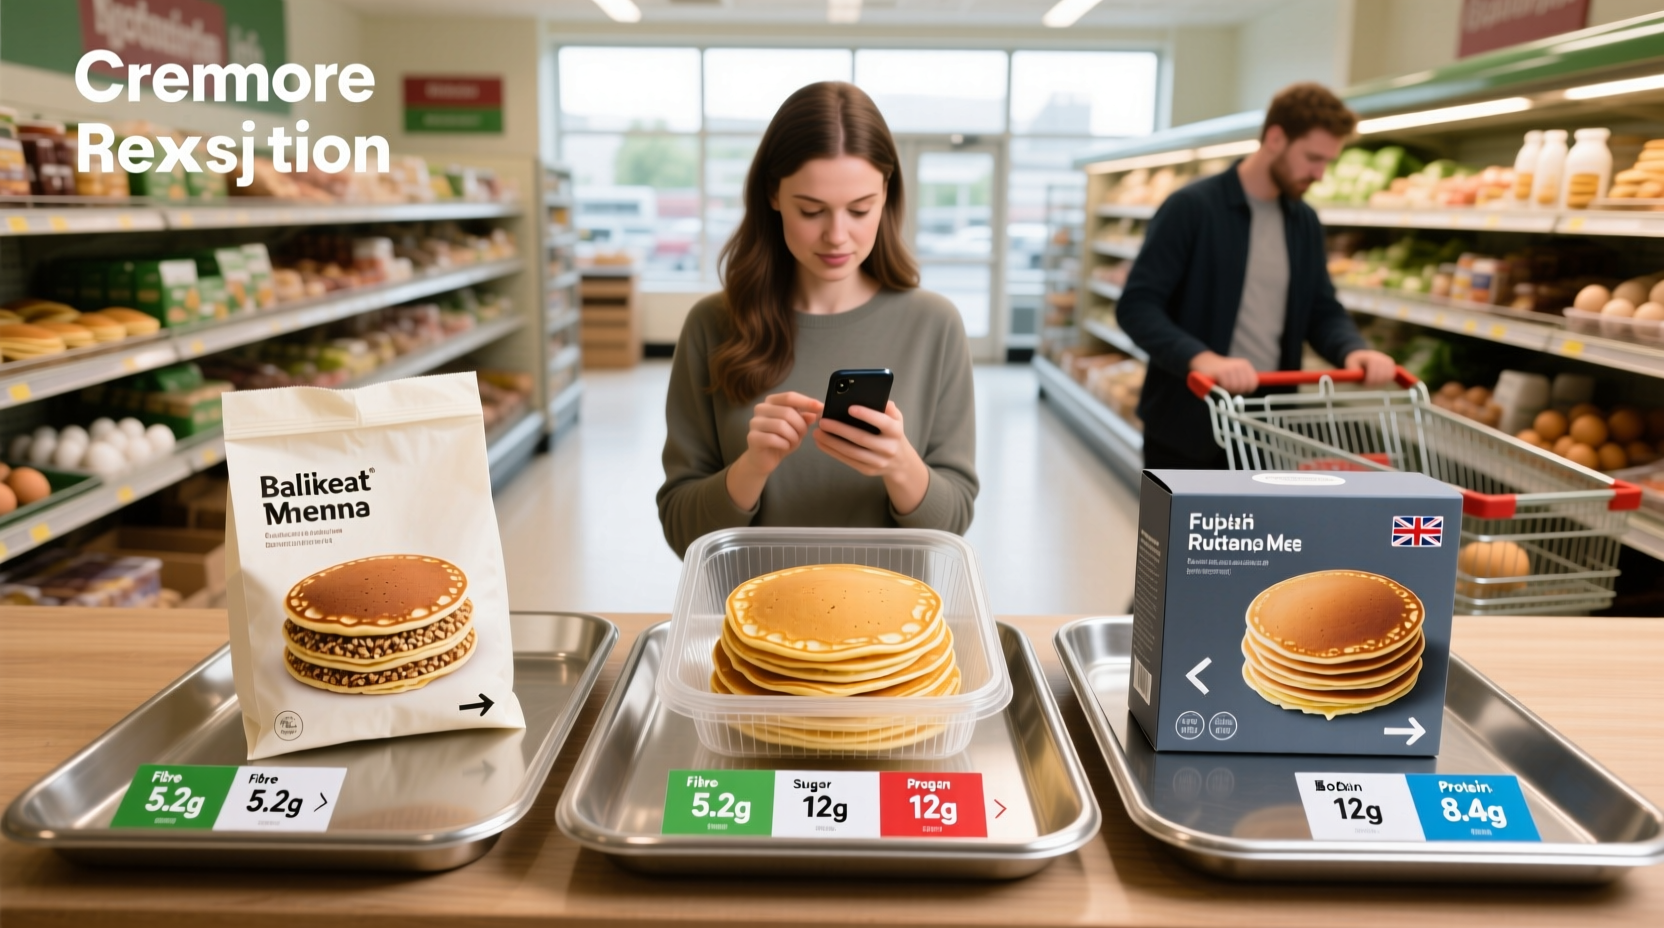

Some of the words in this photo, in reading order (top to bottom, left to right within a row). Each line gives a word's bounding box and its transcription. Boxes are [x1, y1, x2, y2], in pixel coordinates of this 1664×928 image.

[145, 786, 206, 819] 5.2g
[246, 789, 304, 818] 5.2g
[691, 792, 752, 824] 5.2g
[802, 795, 848, 823] 12g
[909, 794, 958, 825] 12g
[1333, 797, 1384, 825] 12g
[1441, 797, 1508, 829] 8.4g
